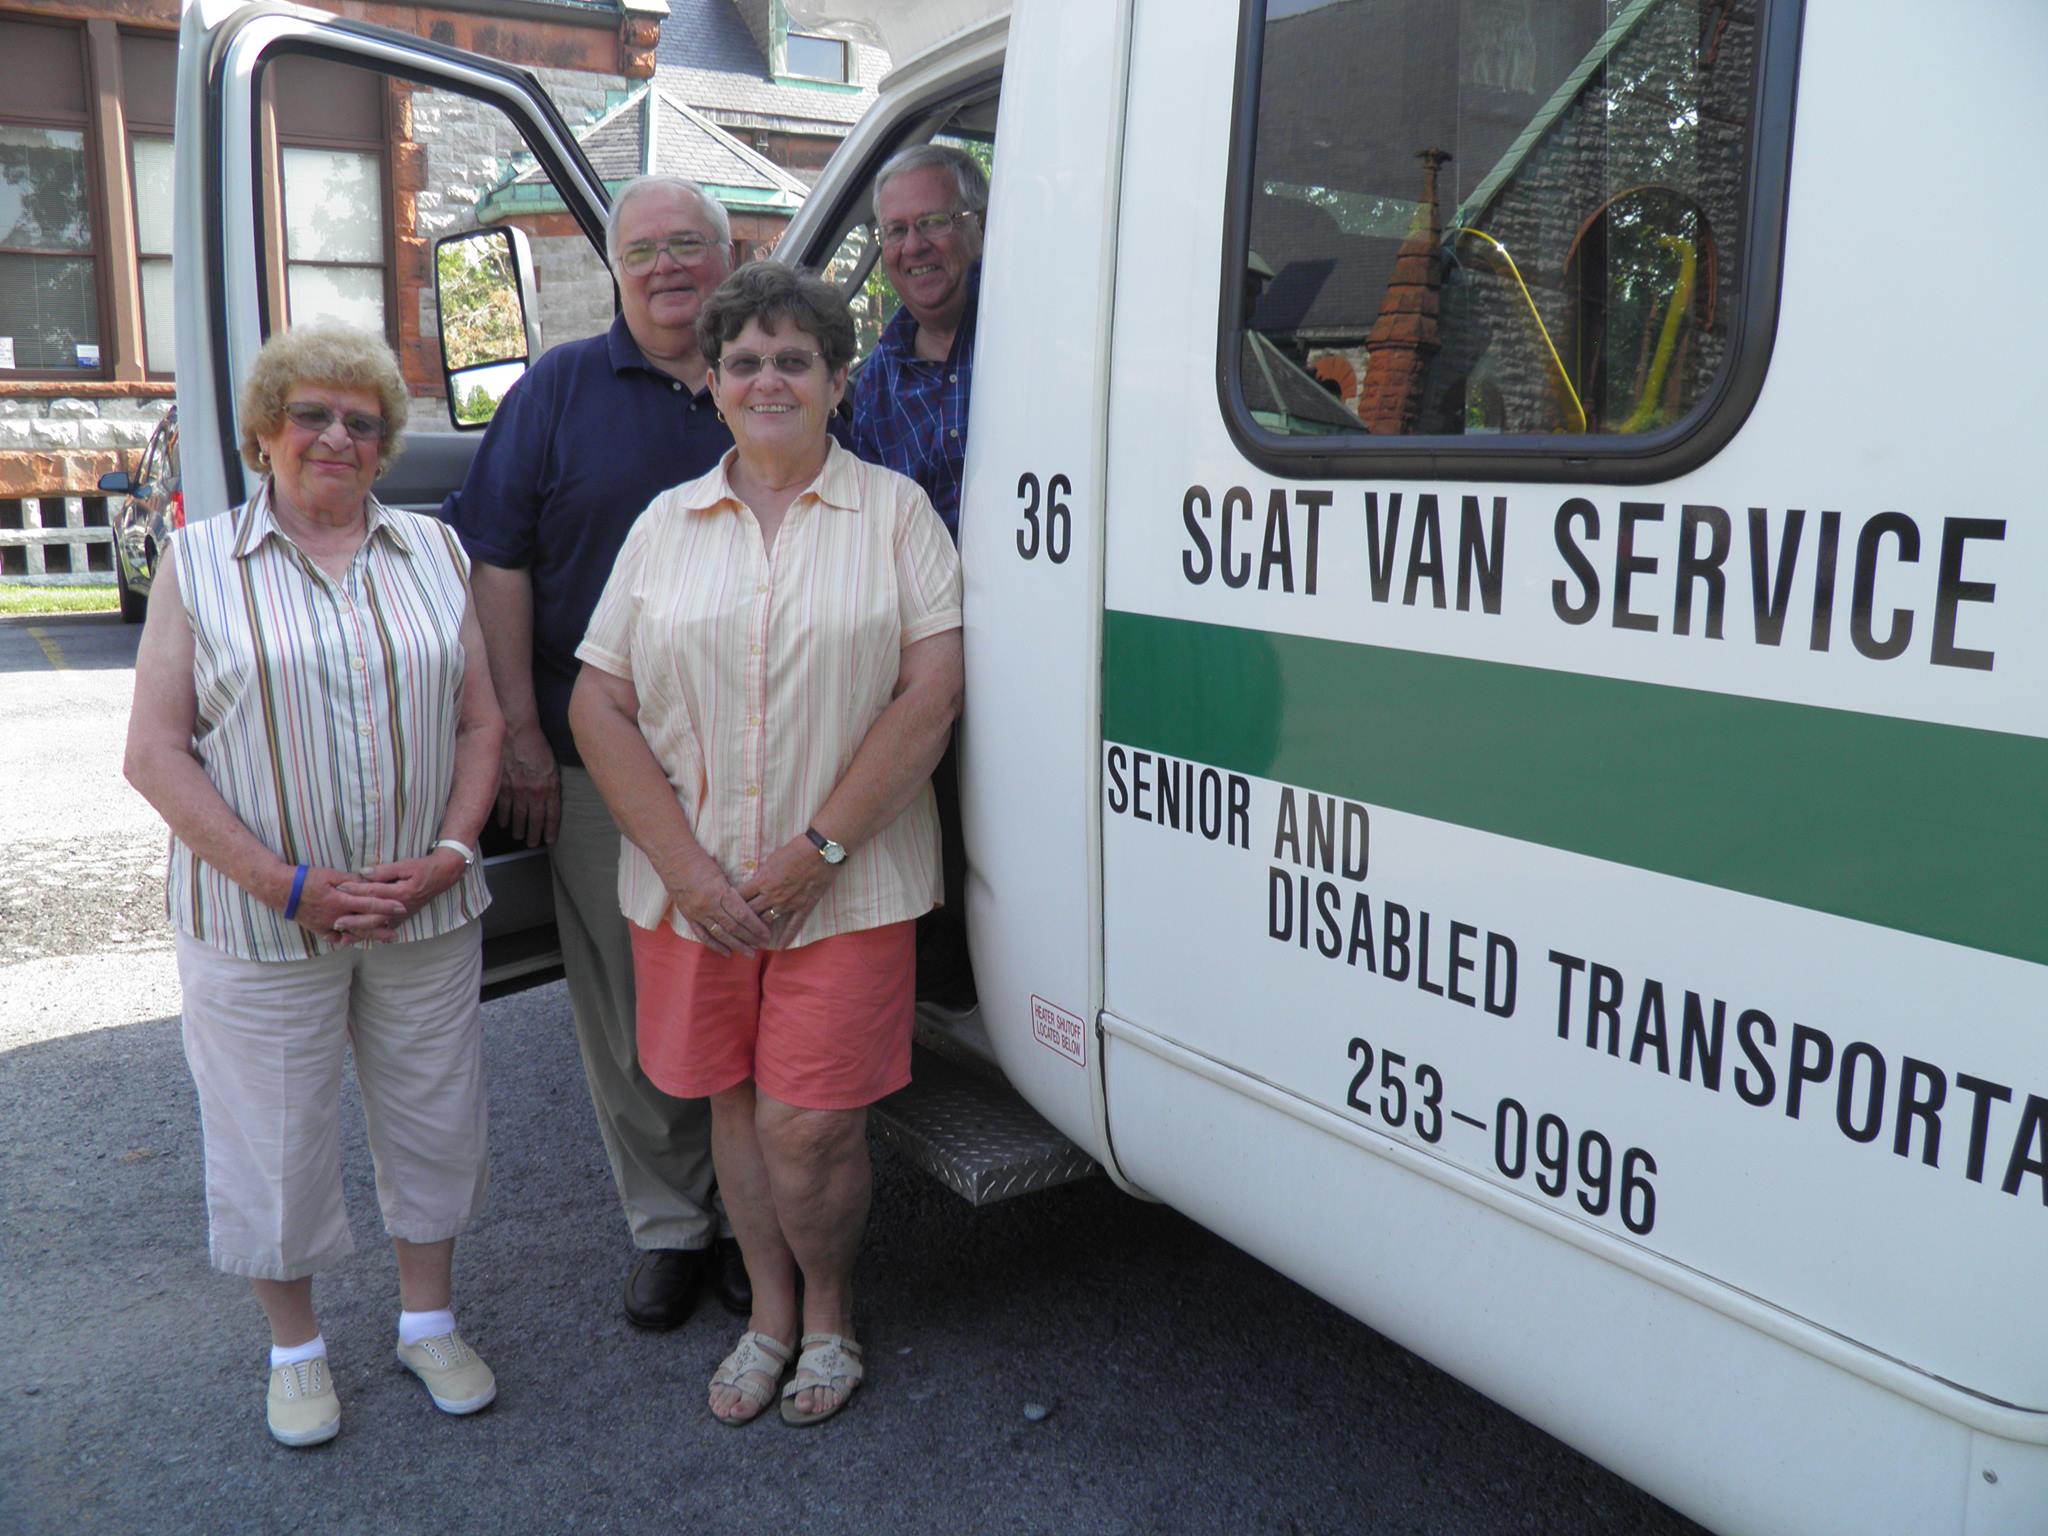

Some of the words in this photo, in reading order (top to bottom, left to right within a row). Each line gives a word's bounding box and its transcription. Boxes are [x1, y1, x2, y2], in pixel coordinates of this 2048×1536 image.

[1016, 472, 1072, 565] 36
[1182, 485, 1334, 596] SCAT
[1364, 491, 1508, 615] VAN
[1551, 497, 2007, 672] SERVICE
[1107, 745, 1251, 851] SENIOR
[1274, 786, 1370, 882] AND
[1034, 1004, 1055, 1025] HEATER
[1036, 1021, 1060, 1046] LOCATED
[1061, 1034, 1080, 1057] BELOW
[1268, 865, 1518, 1019] DISABLED
[1548, 949, 2048, 1208] TRANSPORTA
[1346, 1037, 1658, 1236] 253-0996
